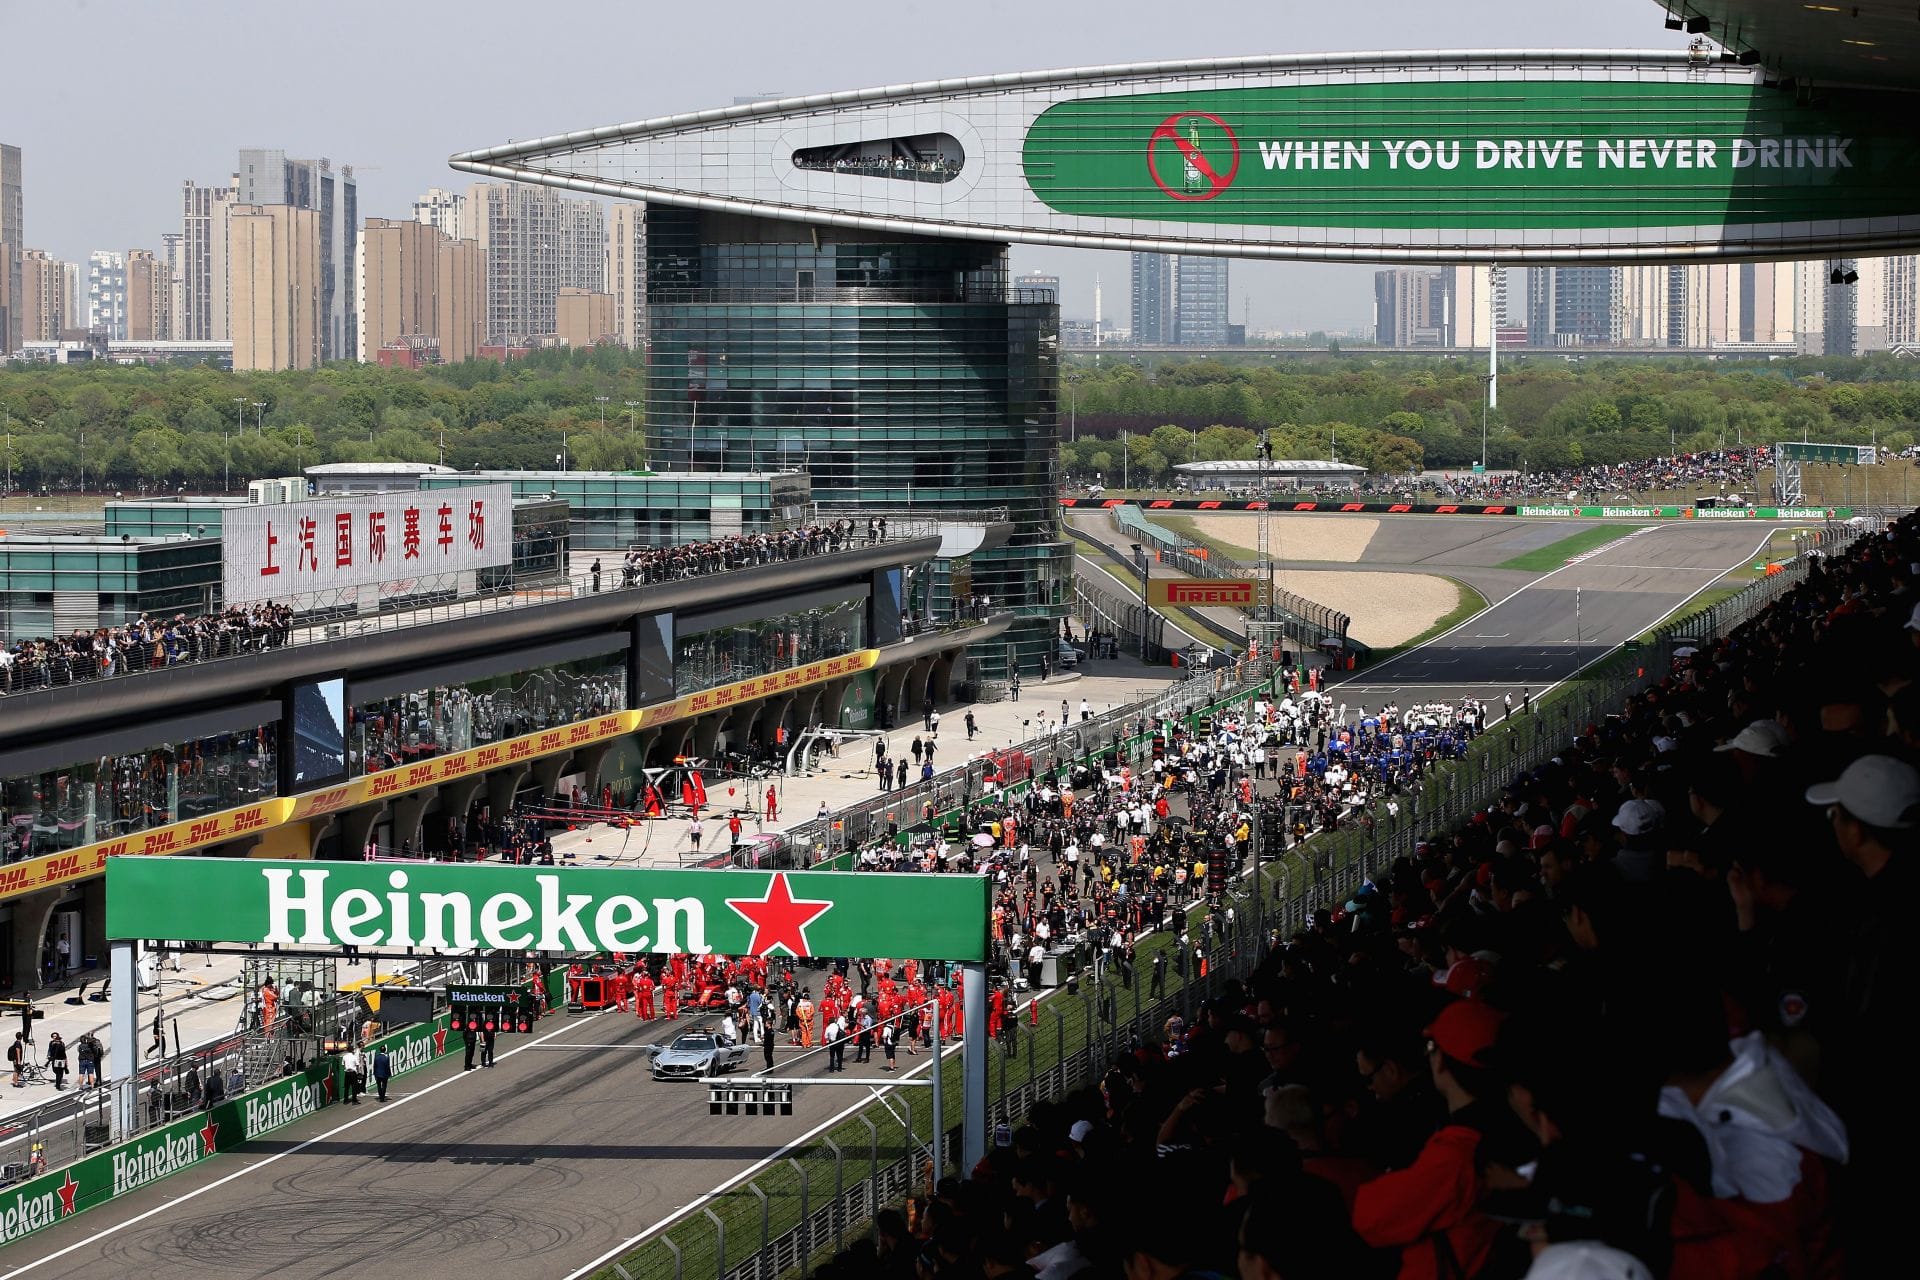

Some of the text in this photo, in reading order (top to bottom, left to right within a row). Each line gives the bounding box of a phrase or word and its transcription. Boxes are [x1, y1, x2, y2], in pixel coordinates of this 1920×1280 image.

[1258, 138, 1853, 170] WHEN YOU DRIVE NEVER DRINK
[1522, 507, 1569, 516] Heineken
[1602, 508, 1650, 517] Heineken
[1698, 508, 1745, 518] Heineken
[1777, 508, 1824, 518] Heineken
[260, 499, 485, 577] 上汽国际赛车场
[1168, 583, 1251, 602] PIRELLI
[570, 724, 591, 743] DHL
[599, 718, 619, 736] DHL
[509, 740, 532, 759] DHL
[541, 732, 562, 751] DHL
[444, 756, 468, 777] DHL
[477, 748, 500, 767] DHL
[373, 774, 399, 795] DHL
[409, 765, 434, 786] DHL
[234, 808, 262, 831] DHL
[190, 820, 220, 842] DHL
[144, 831, 176, 855] DHL
[46, 855, 80, 880] DHL
[262, 868, 712, 954] Heineken
[451, 991, 505, 1002] Heineken
[366, 1035, 432, 1087] Hneken
[245, 1081, 321, 1139] Heineken
[113, 1133, 198, 1197] Heineken
